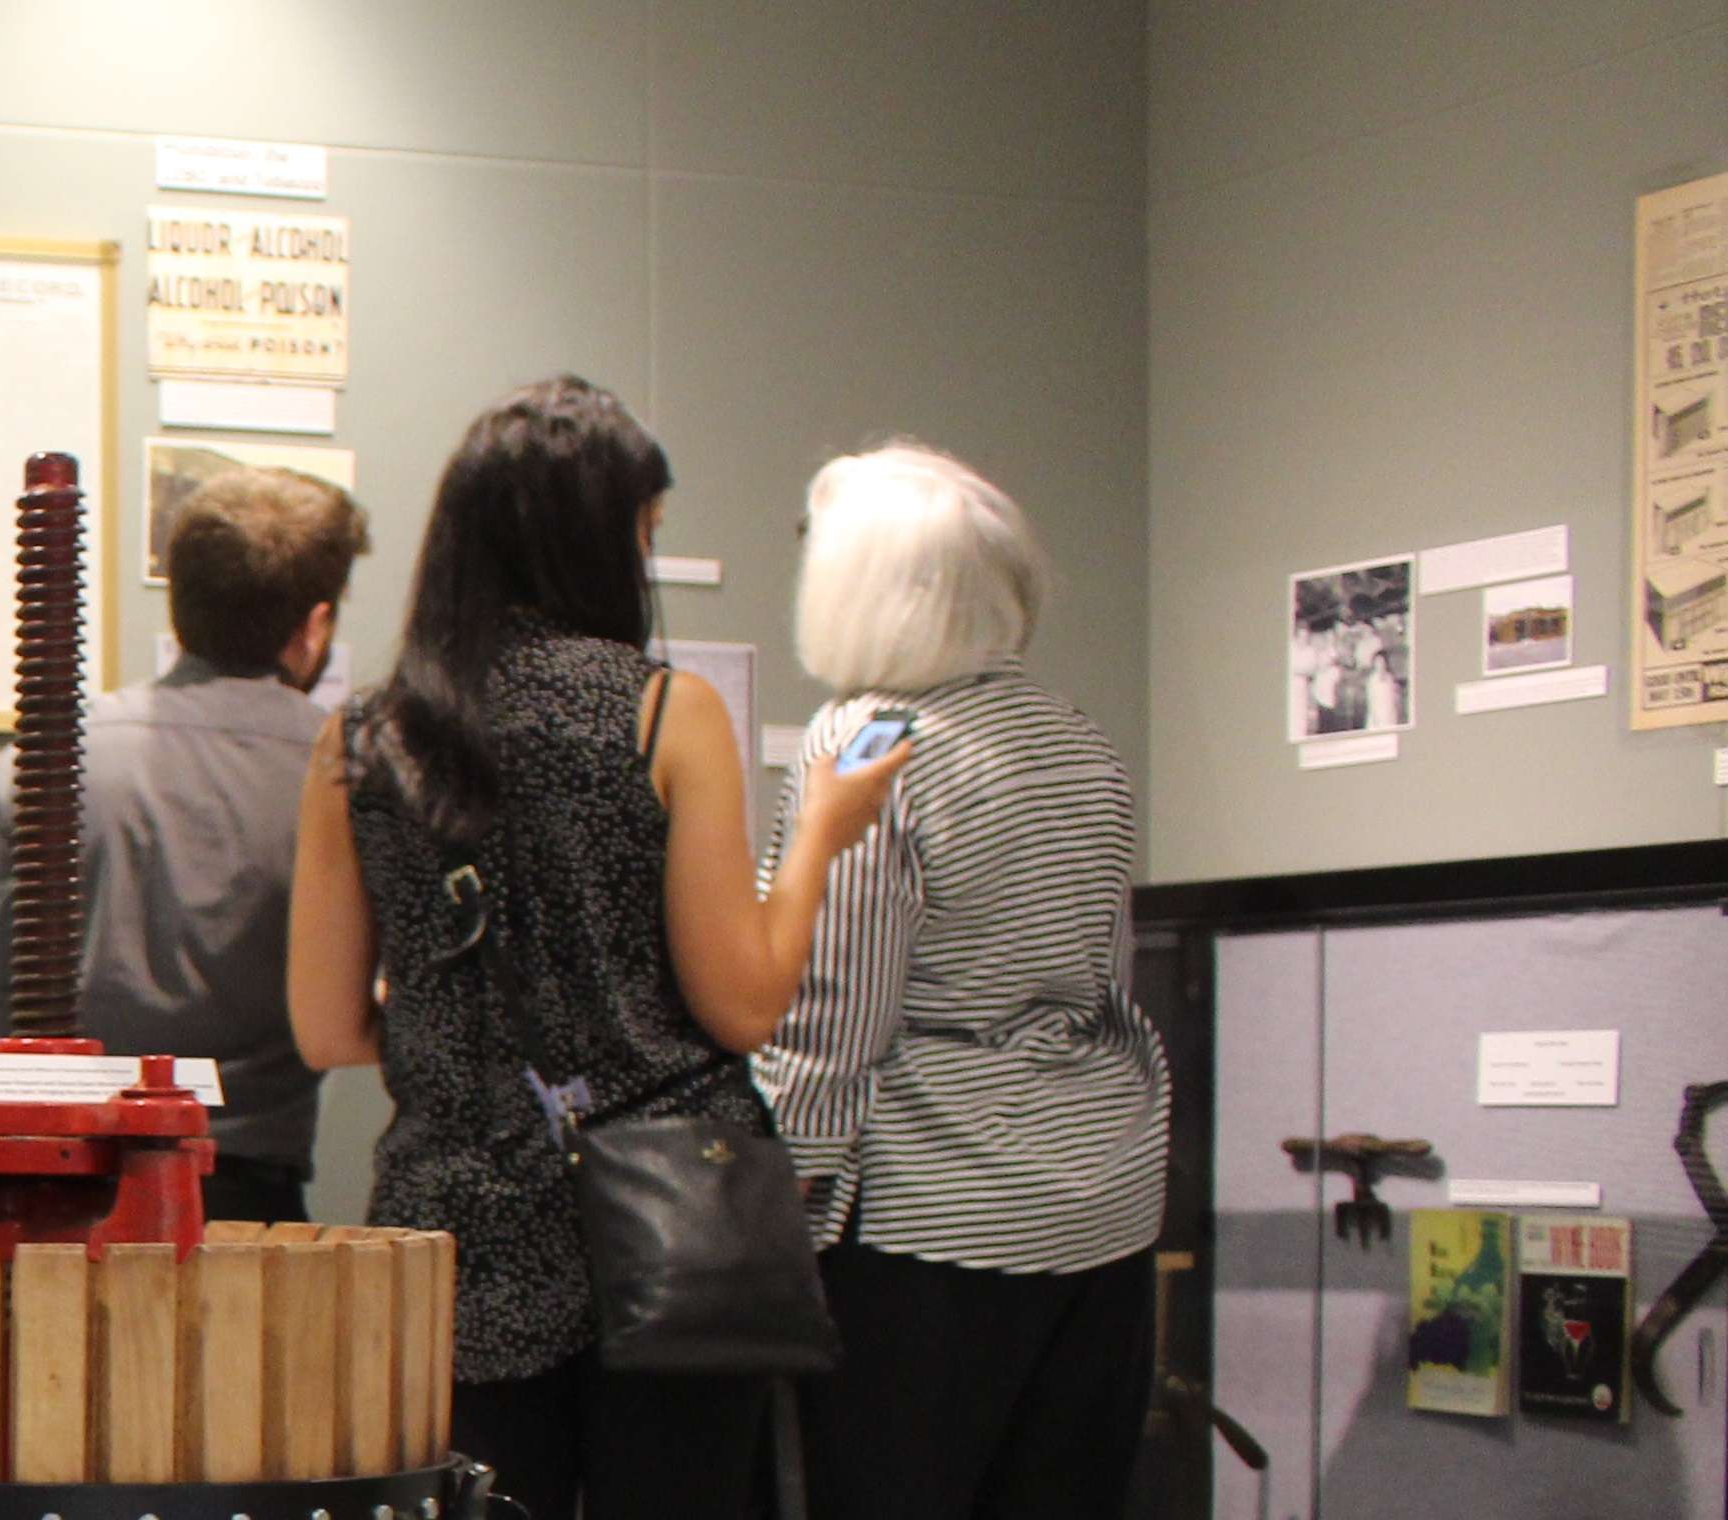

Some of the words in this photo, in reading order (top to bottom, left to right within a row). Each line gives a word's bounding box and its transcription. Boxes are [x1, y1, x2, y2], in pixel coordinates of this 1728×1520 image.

[146, 217, 232, 256] LIQUOR
[250, 223, 349, 265] ALCOHOL
[147, 275, 245, 313] ALCOHOL
[260, 281, 343, 318] POISON
